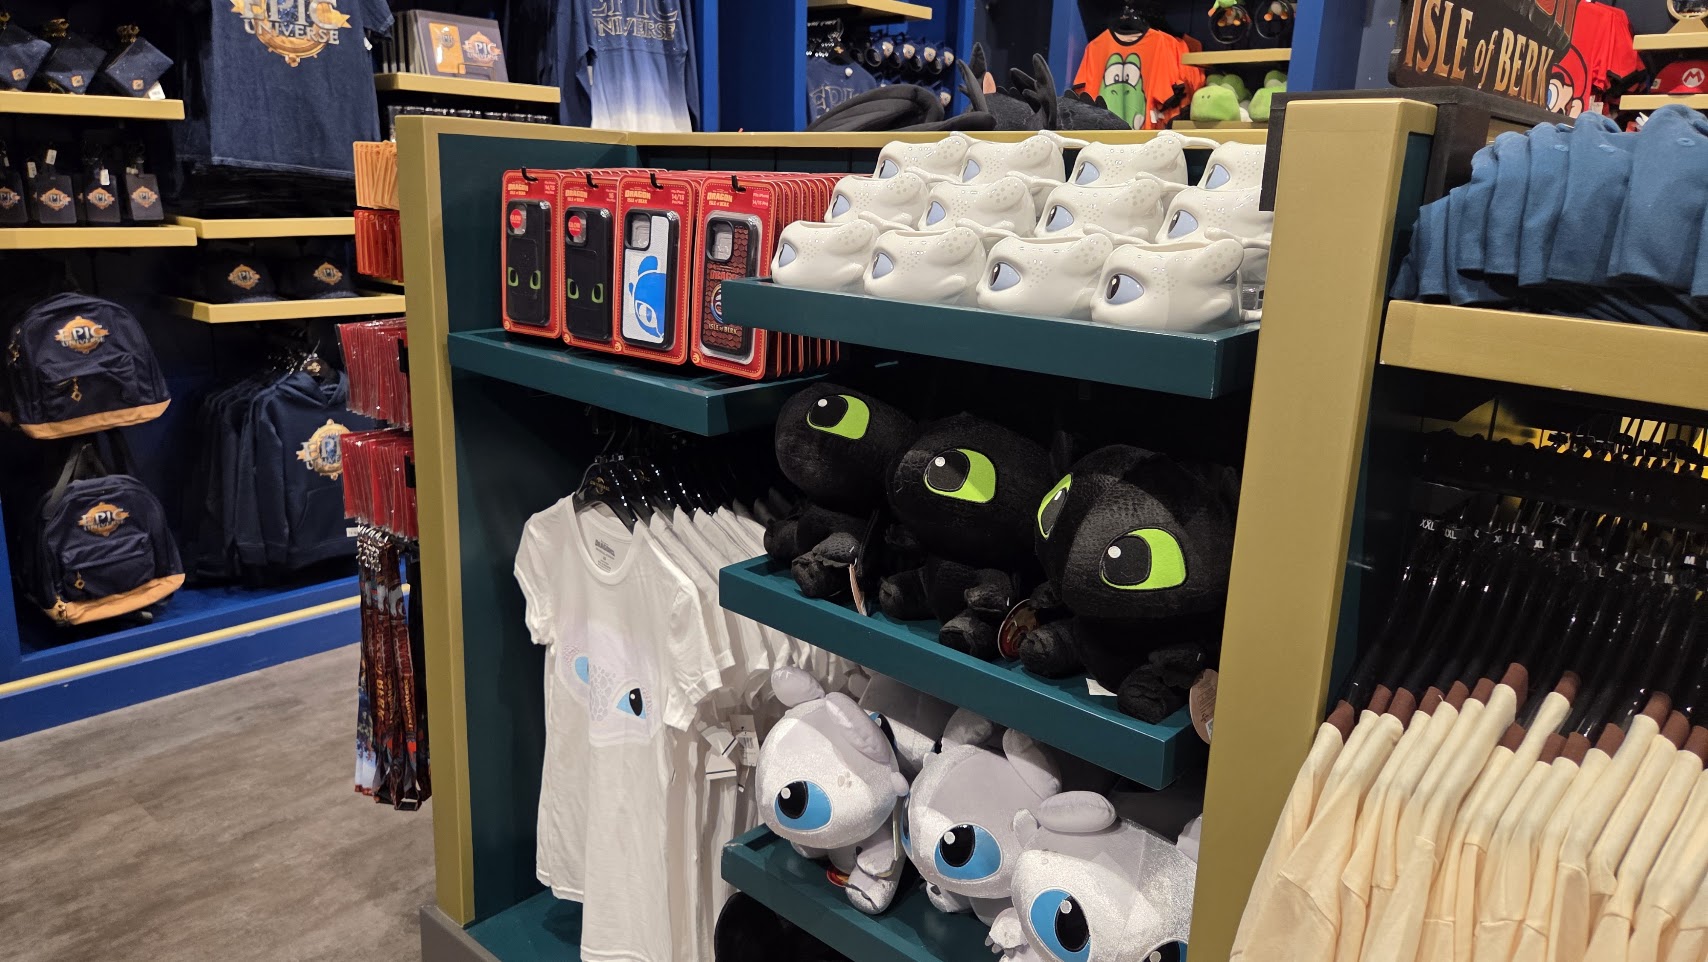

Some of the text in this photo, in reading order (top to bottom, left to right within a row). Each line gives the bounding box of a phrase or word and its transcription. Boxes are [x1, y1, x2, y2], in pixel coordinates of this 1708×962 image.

[240, 0, 338, 30] EPIC
[244, 18, 340, 45] UNIVERSE
[594, 17, 676, 40] NIVERSE
[1403, 0, 1473, 81] ISLE
[1473, 30, 1499, 90] of
[1493, 27, 1554, 108] BERK
[625, 190, 651, 199] DRAGON
[707, 192, 732, 202] DRAGON
[709, 323, 719, 331] ISLE
[301, 436, 341, 462] EPI
[1420, 519, 1435, 531] XXL
[1552, 515, 1566, 526] XL
[1534, 539, 1544, 549] XL
[1684, 556, 1696, 566] M
